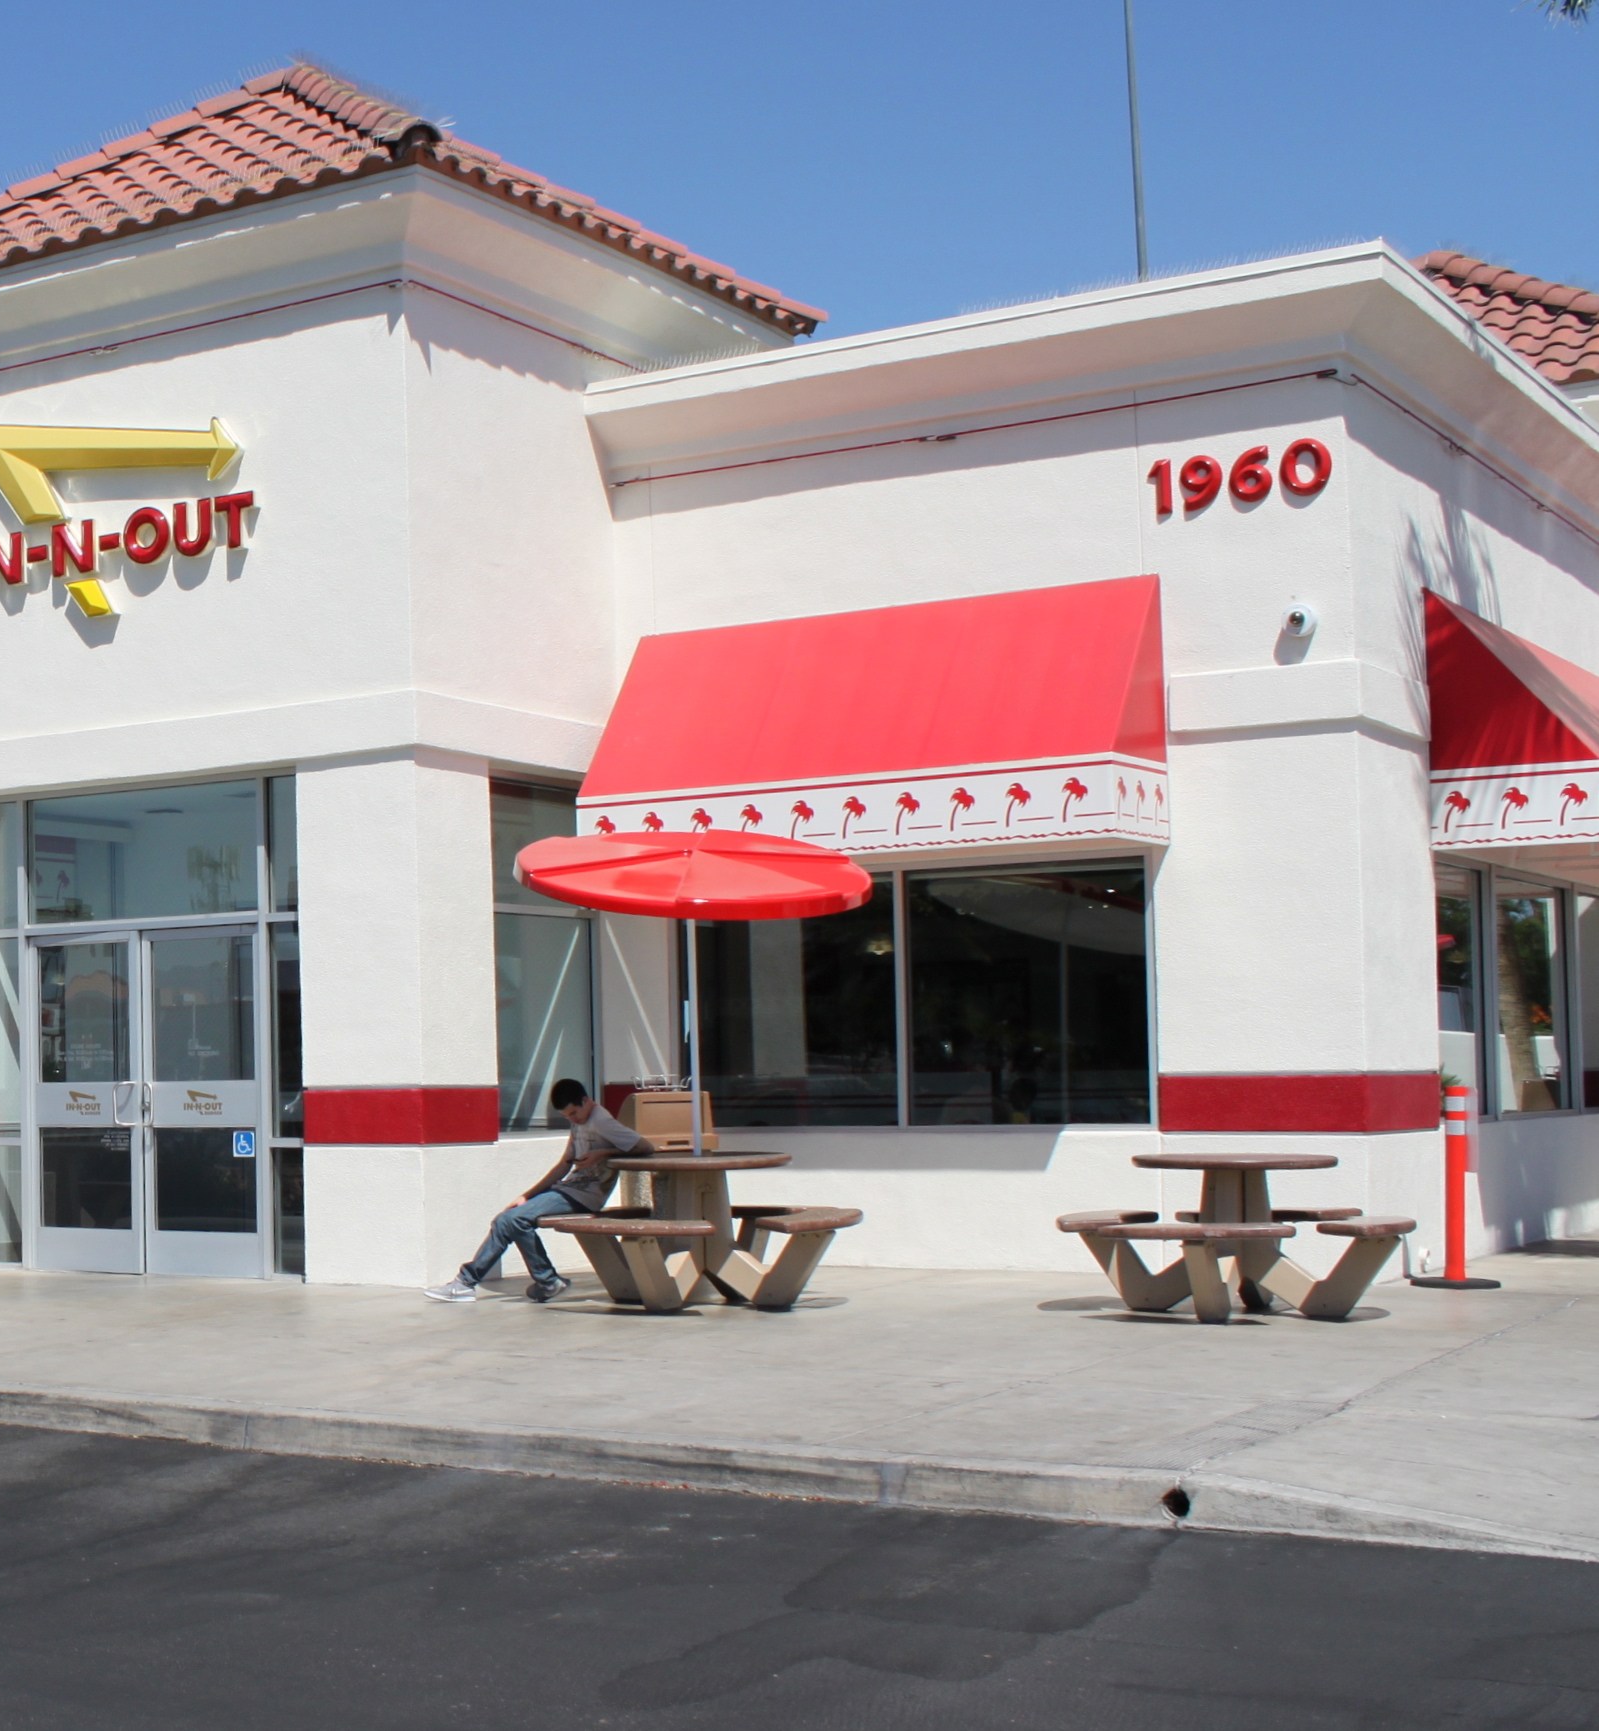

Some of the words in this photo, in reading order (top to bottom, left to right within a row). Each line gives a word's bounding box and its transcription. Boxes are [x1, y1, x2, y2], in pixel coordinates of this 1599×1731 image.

[1146, 437, 1333, 515] 1960
[65, 1103, 101, 1111] IN-N-OUT
[183, 1102, 223, 1111] IN-N-OUT
